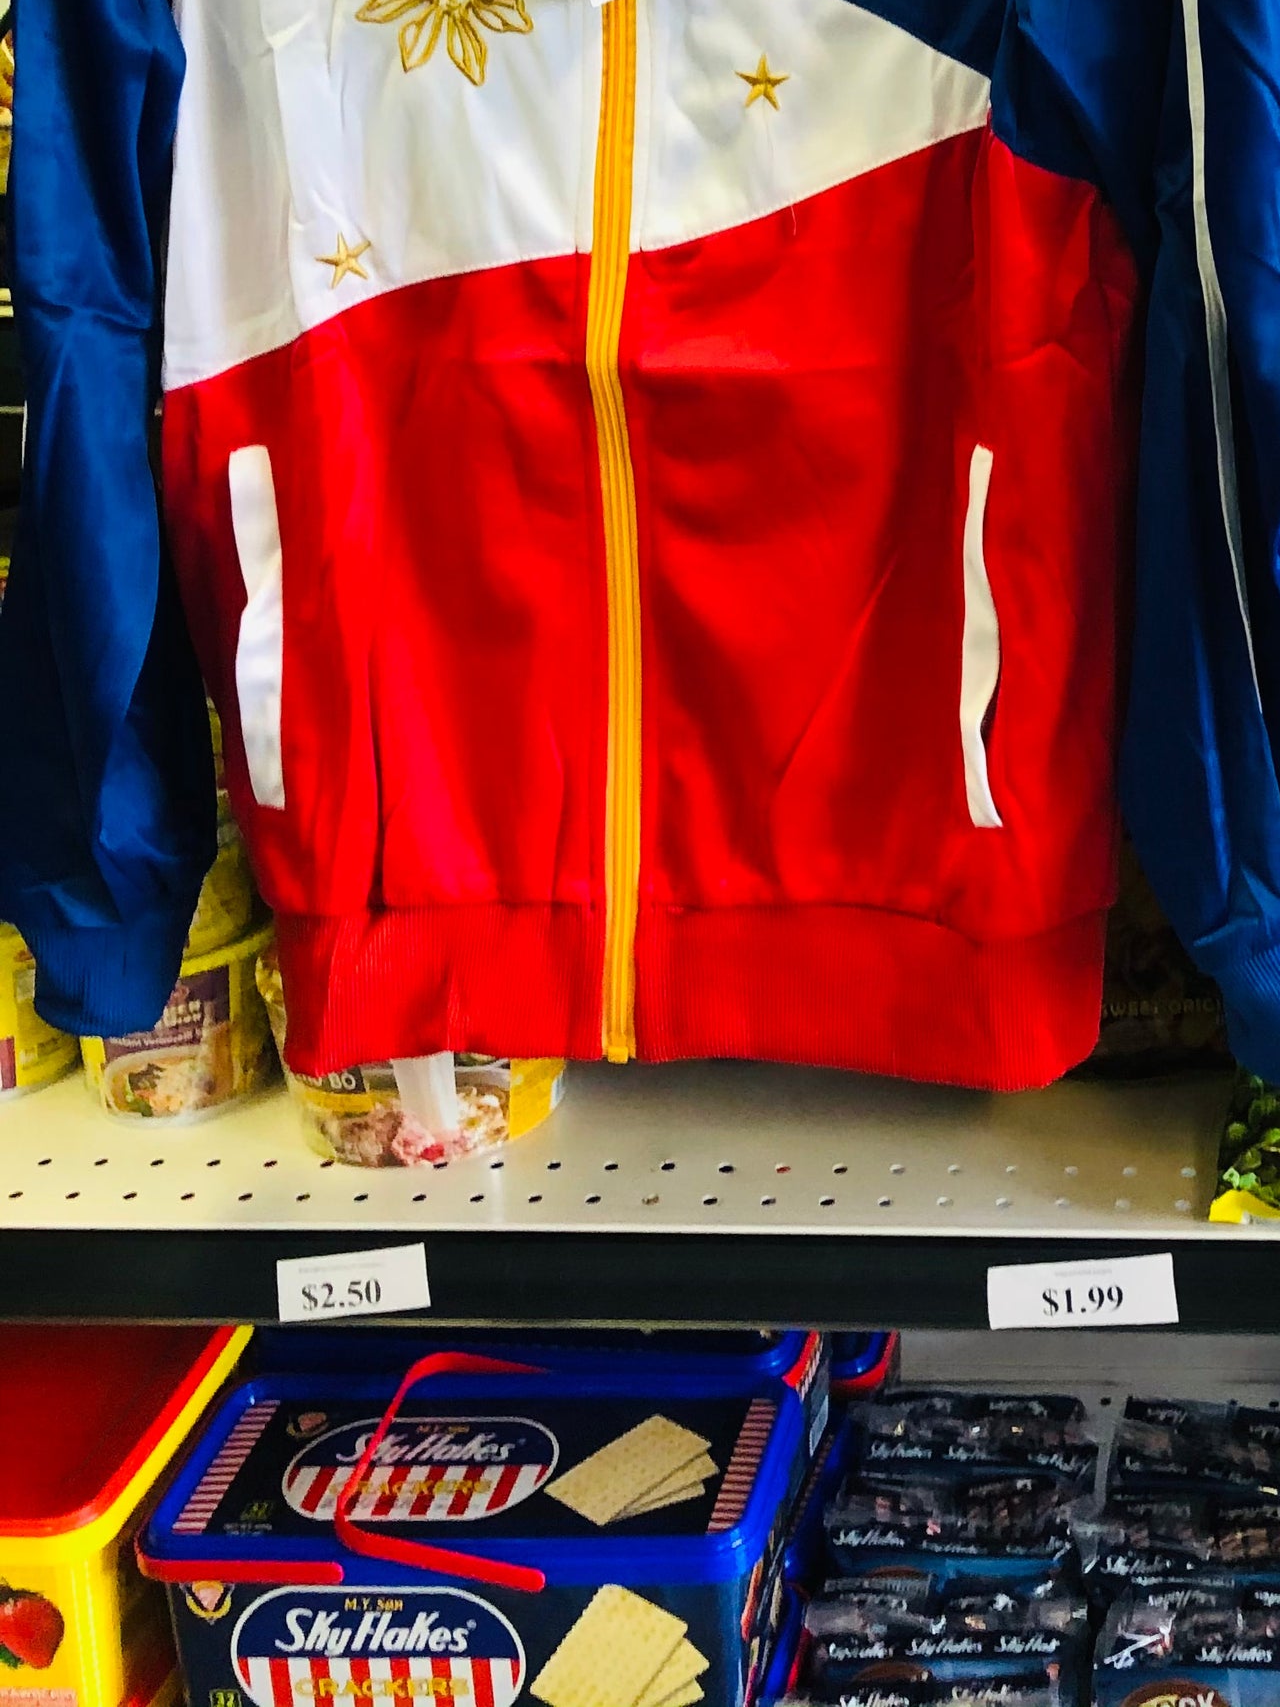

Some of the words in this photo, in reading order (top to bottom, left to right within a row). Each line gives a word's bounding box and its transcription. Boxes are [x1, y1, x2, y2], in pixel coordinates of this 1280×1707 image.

[301, 1278, 382, 1312] $2.50
[1042, 1283, 1124, 1318] $1.99
[275, 1607, 470, 1657] SkyFlakes
[294, 1677, 470, 1699] CRACKERS
